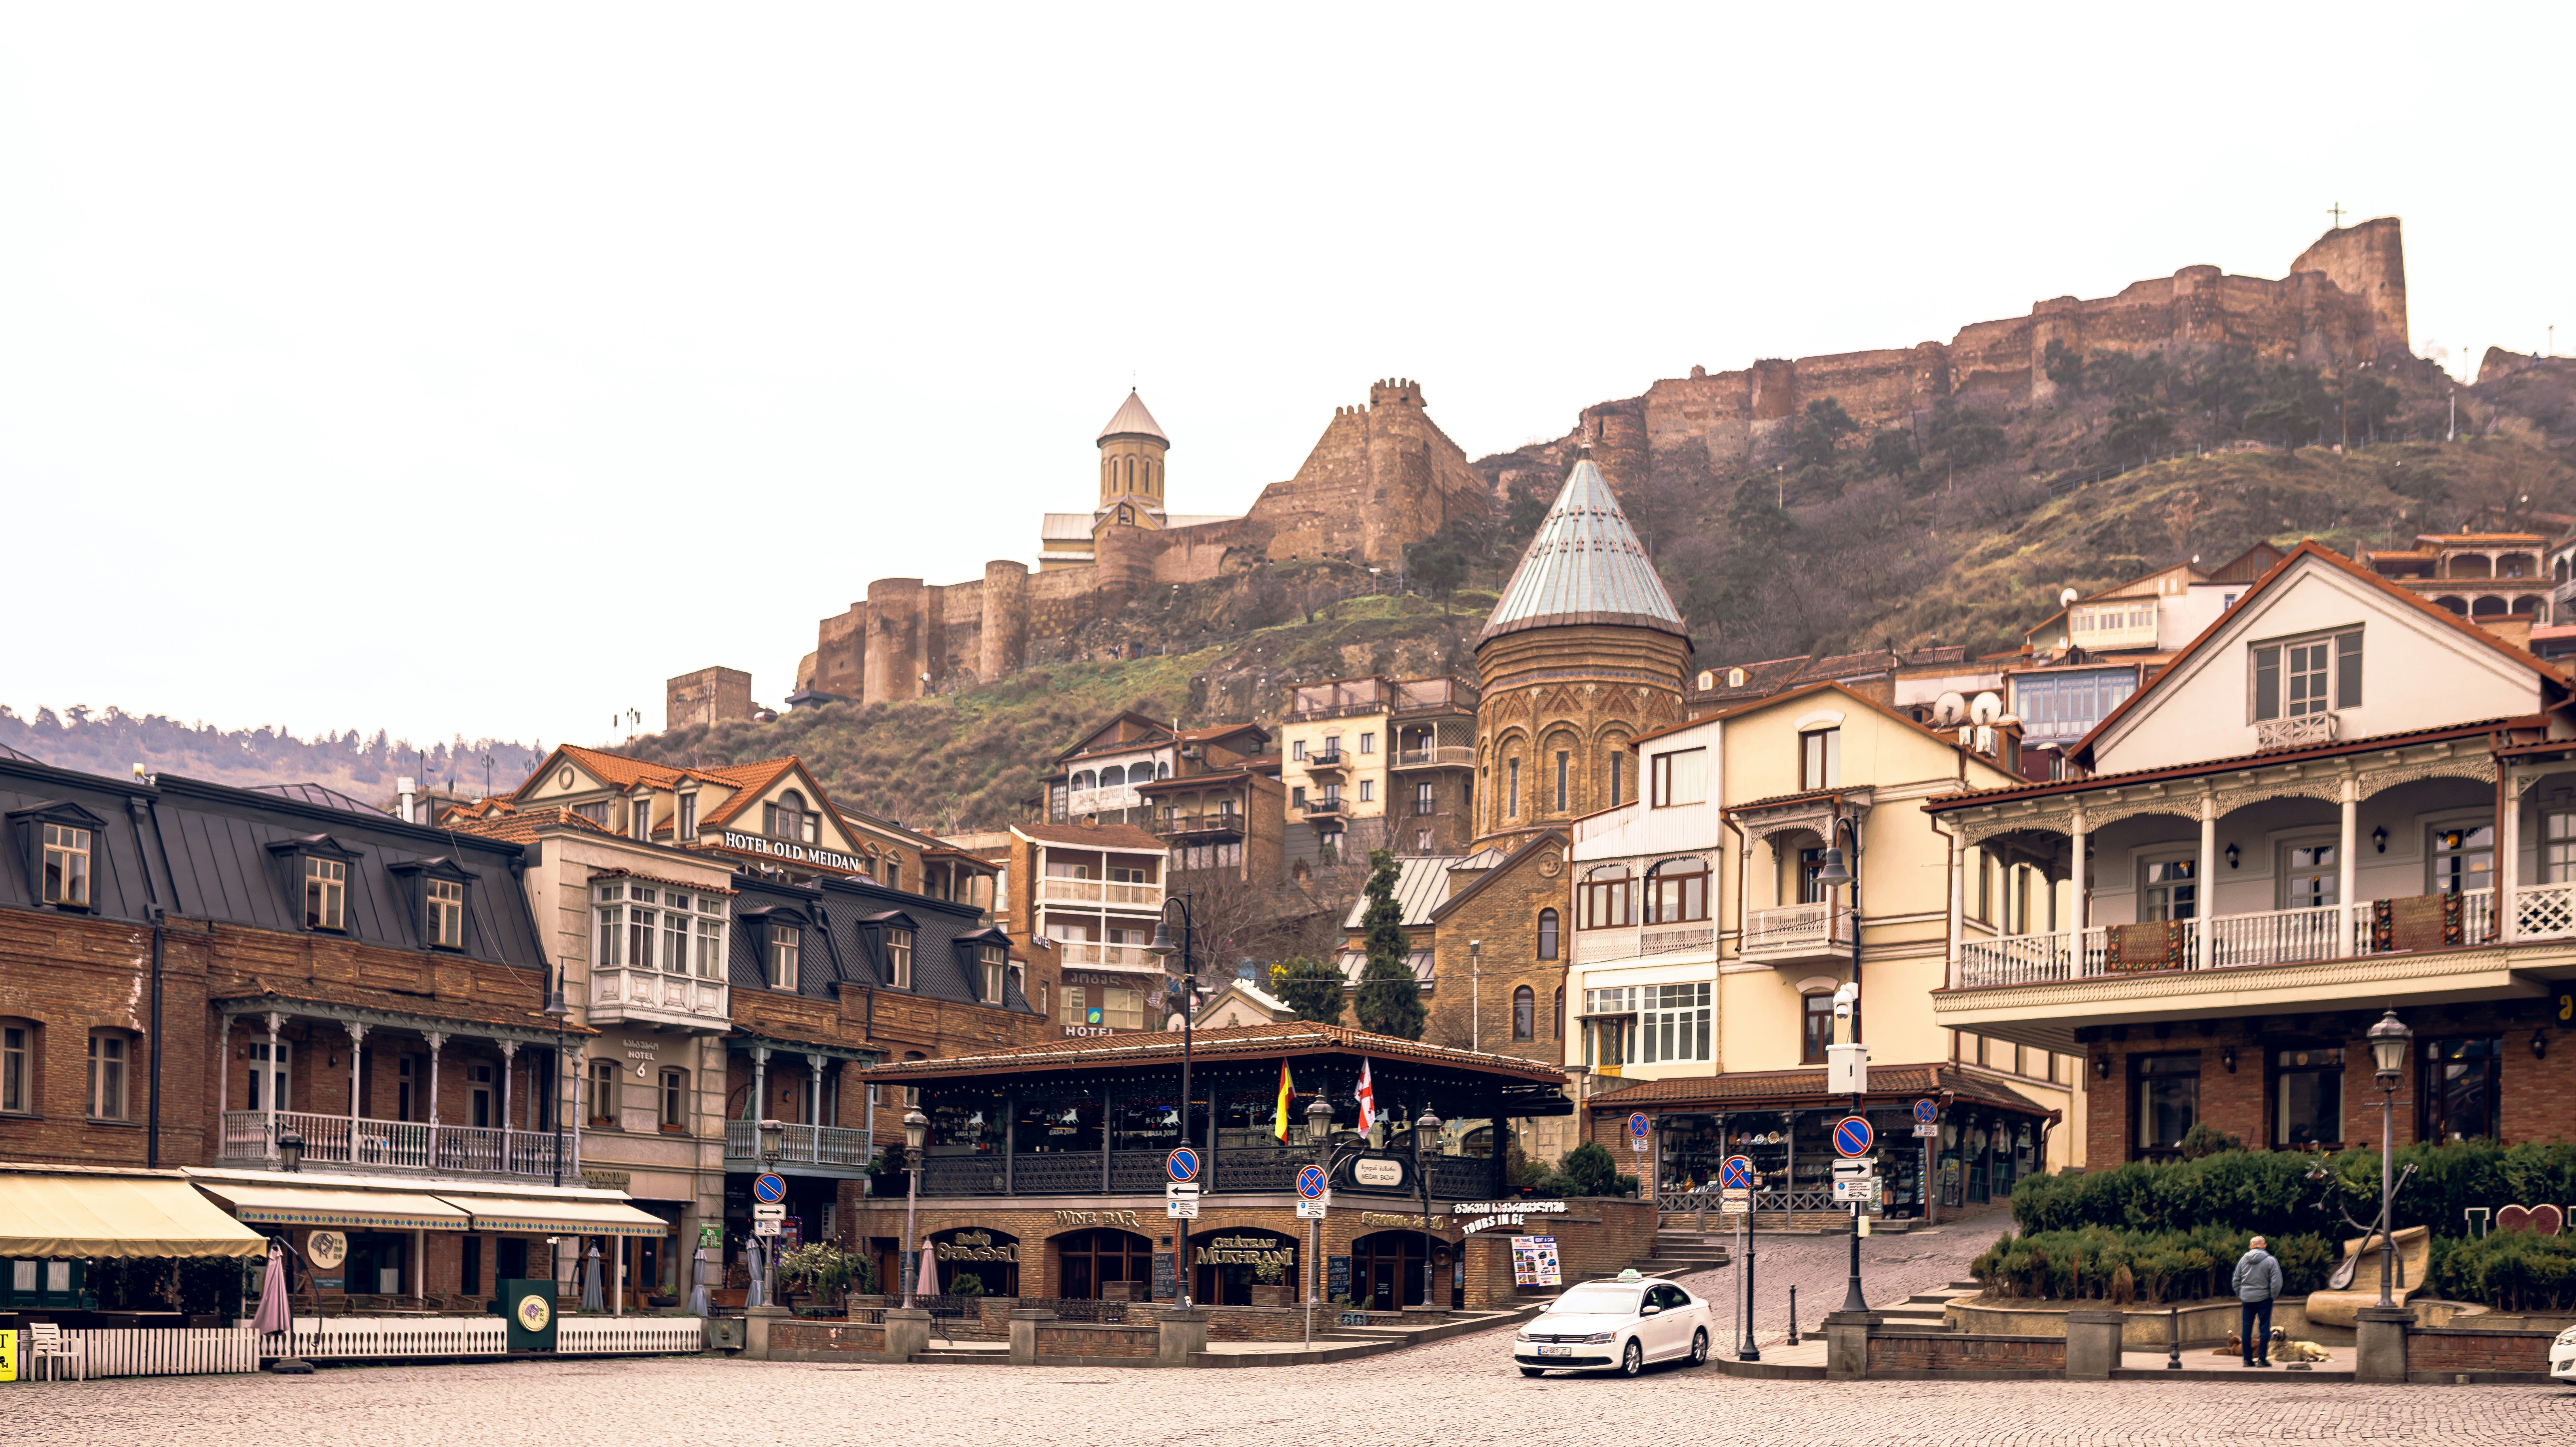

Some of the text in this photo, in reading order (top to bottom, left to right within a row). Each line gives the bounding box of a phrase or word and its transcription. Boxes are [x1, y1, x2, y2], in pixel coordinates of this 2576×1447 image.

[726, 832, 858, 871] HOTEL OLD MEIDAN
[1032, 933, 1052, 949] HOTEL
[1071, 973, 1121, 986] ჰოტელ
[627, 1050, 655, 1060] HOTEL
[637, 1062, 646, 1077] 6
[1054, 1210, 1140, 1228] WINE BAR
[1462, 1213, 1525, 1234] TOURS IN GE
[1212, 1235, 1277, 1249] CHÂTEAU
[1195, 1247, 1294, 1266] MUKHRANI
